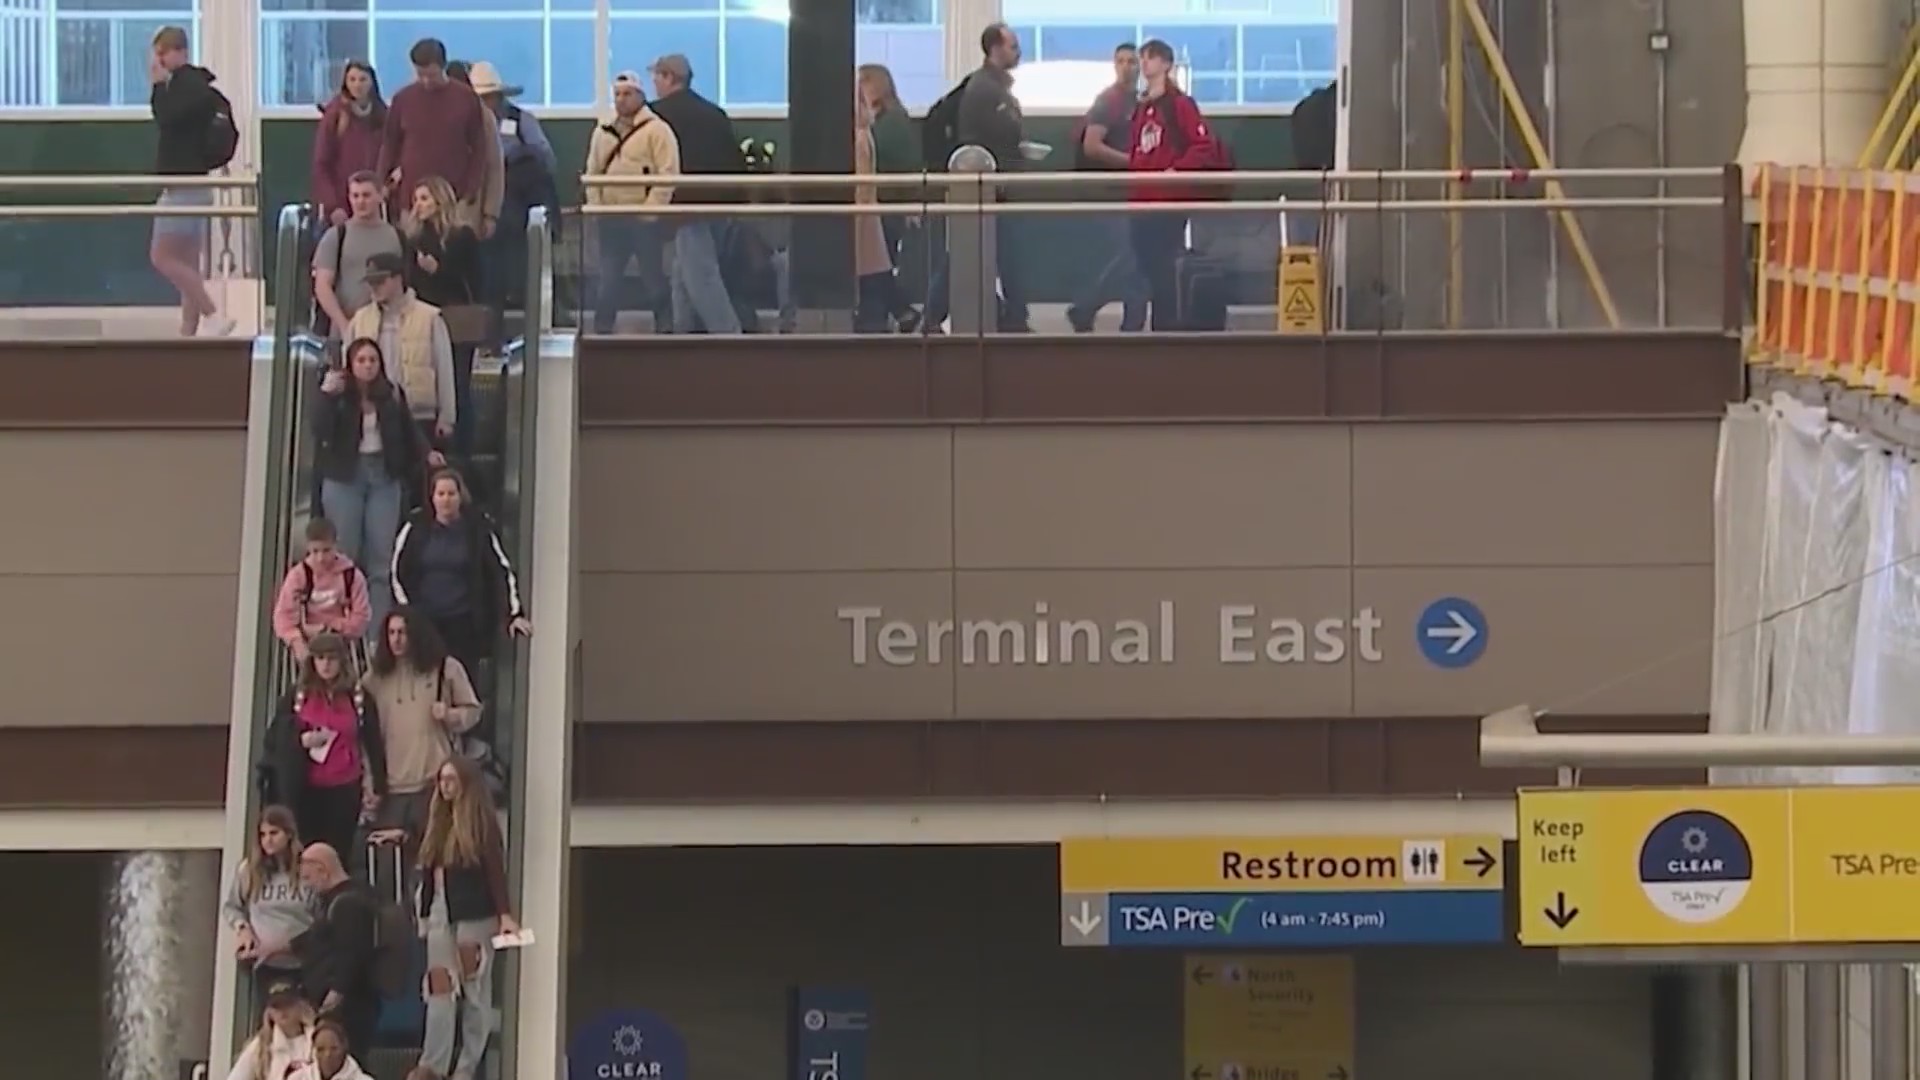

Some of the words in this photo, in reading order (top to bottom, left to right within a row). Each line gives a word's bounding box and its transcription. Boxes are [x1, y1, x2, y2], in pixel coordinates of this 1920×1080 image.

[838, 601, 1174, 665] Terminal
[1219, 605, 1382, 664] East
[1533, 819, 1584, 840] Keep
[1541, 844, 1576, 863] left
[1829, 853, 1875, 875] TSA
[1222, 850, 1397, 880] Restroom
[1667, 858, 1723, 873] CLEAR
[1120, 906, 1168, 931] TSA
[1174, 906, 1215, 931] Pre
[1261, 911, 1277, 929] (4
[1280, 914, 1305, 926] am
[1318, 911, 1350, 926] 7:45
[1353, 909, 1385, 930] pm)
[597, 1062, 661, 1078] CLEAR
